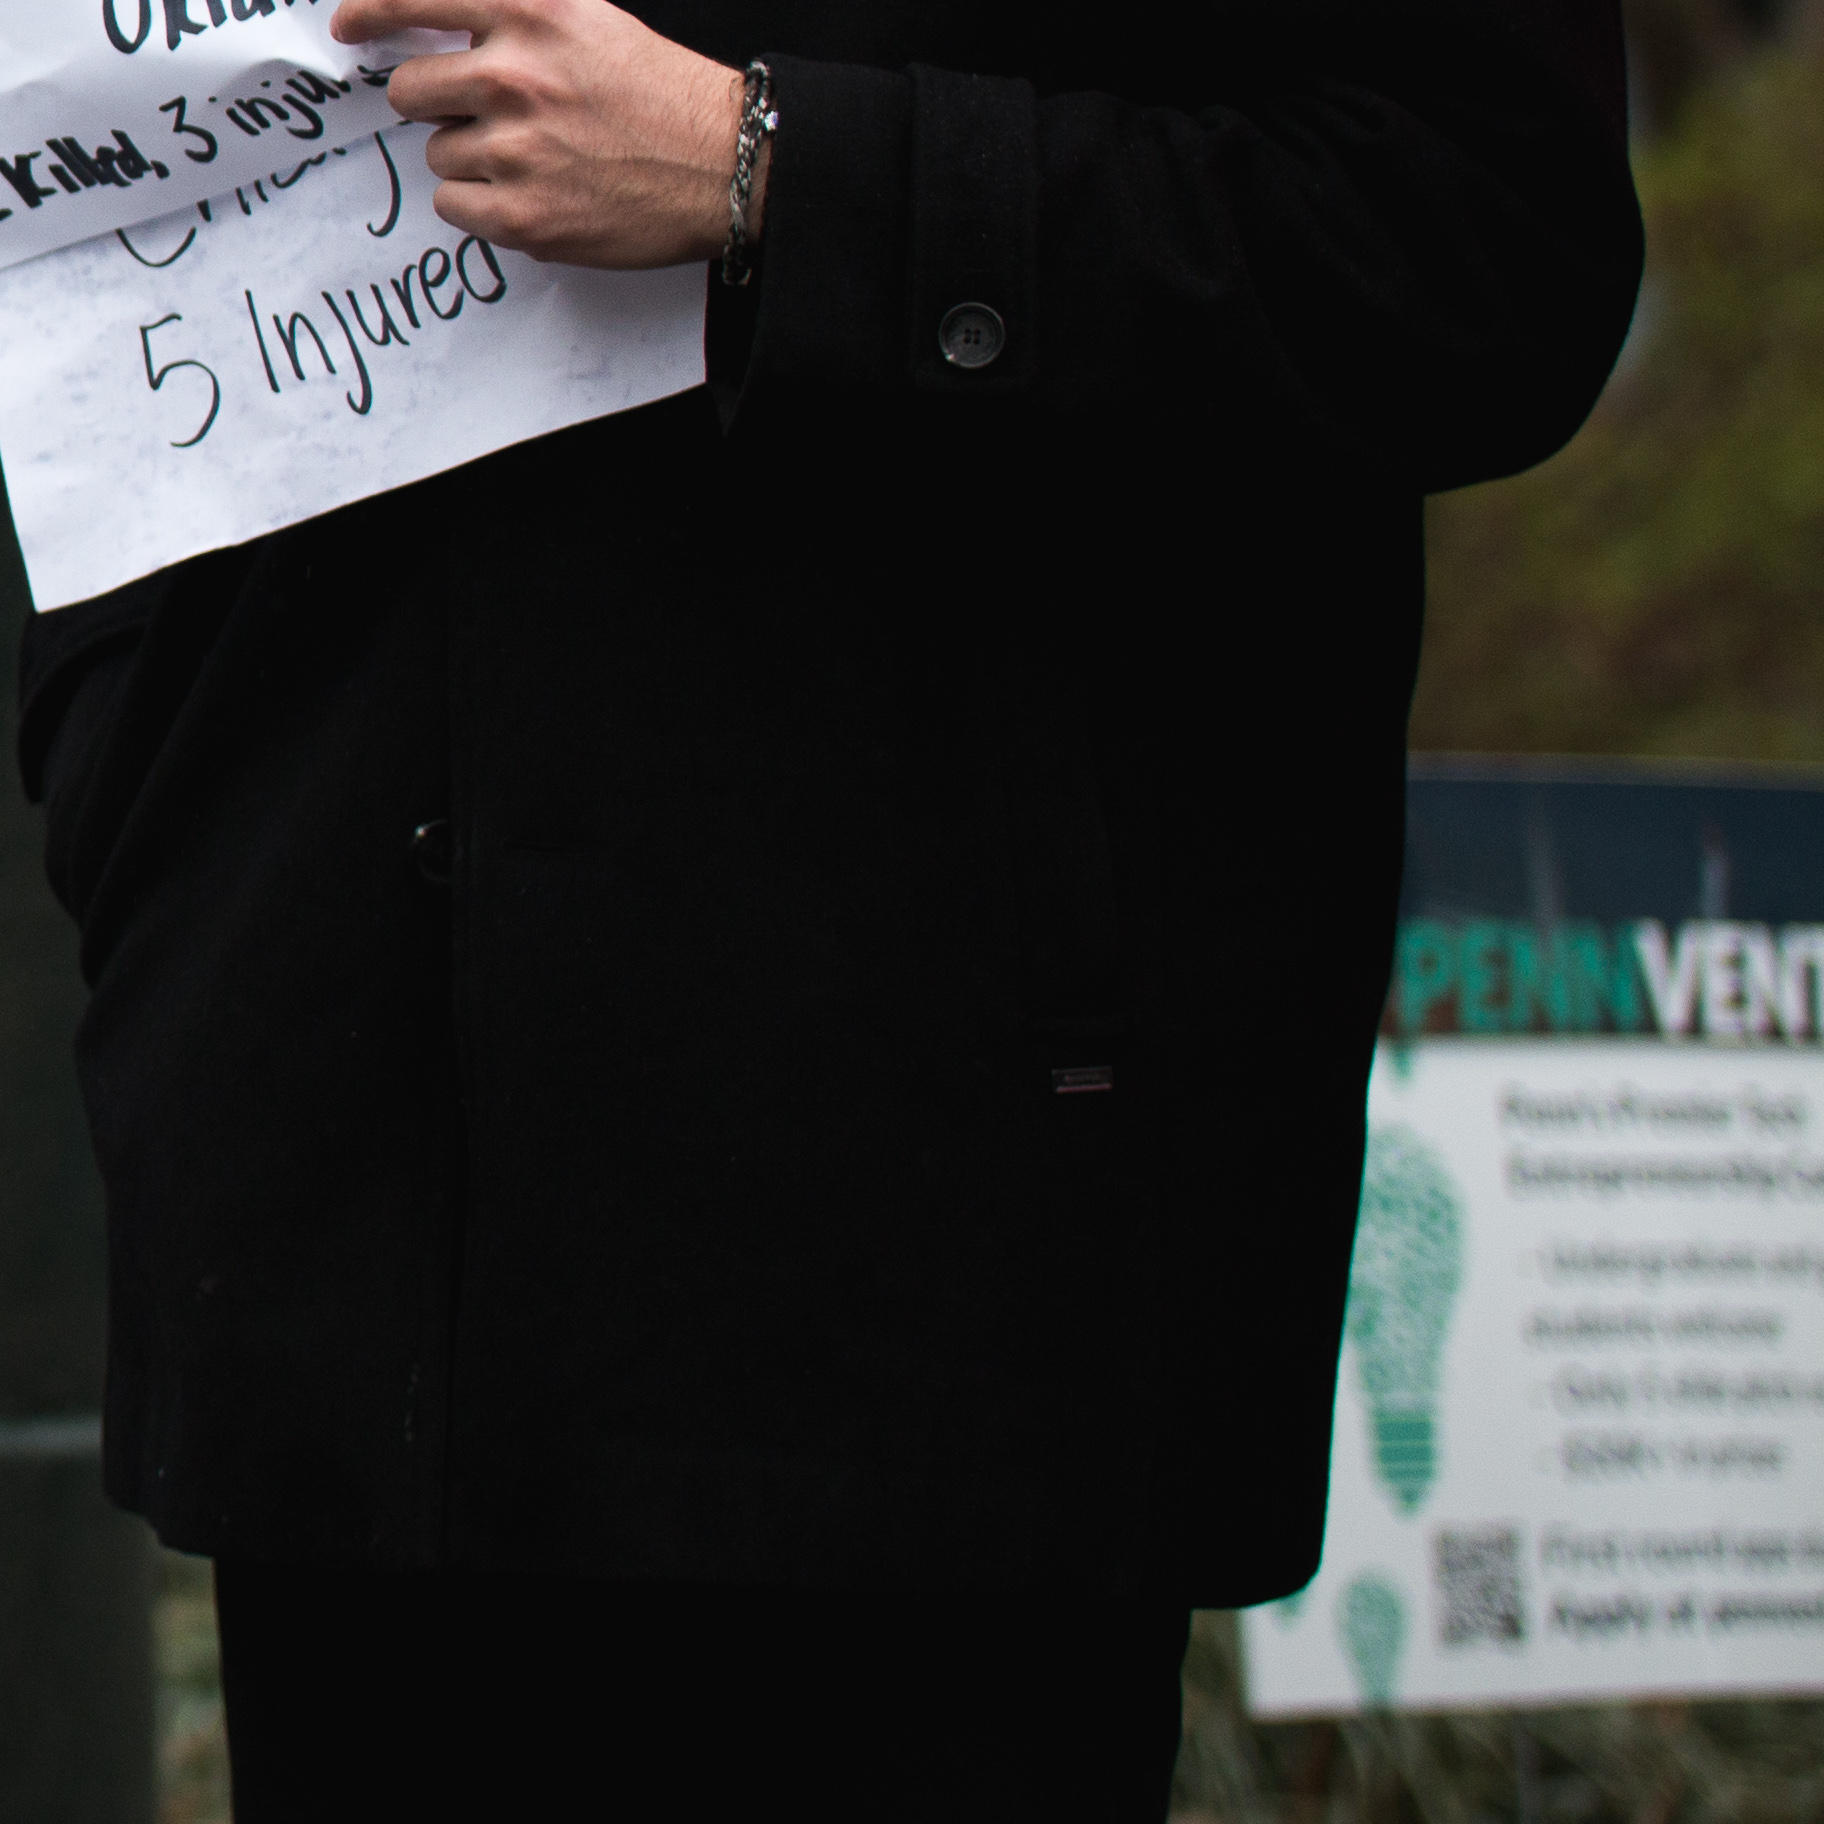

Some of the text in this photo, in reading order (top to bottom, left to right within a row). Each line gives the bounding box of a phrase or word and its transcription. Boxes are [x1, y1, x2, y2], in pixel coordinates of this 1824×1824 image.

[158, 95, 218, 164] 3
[140, 236, 508, 448] 5 Injured
